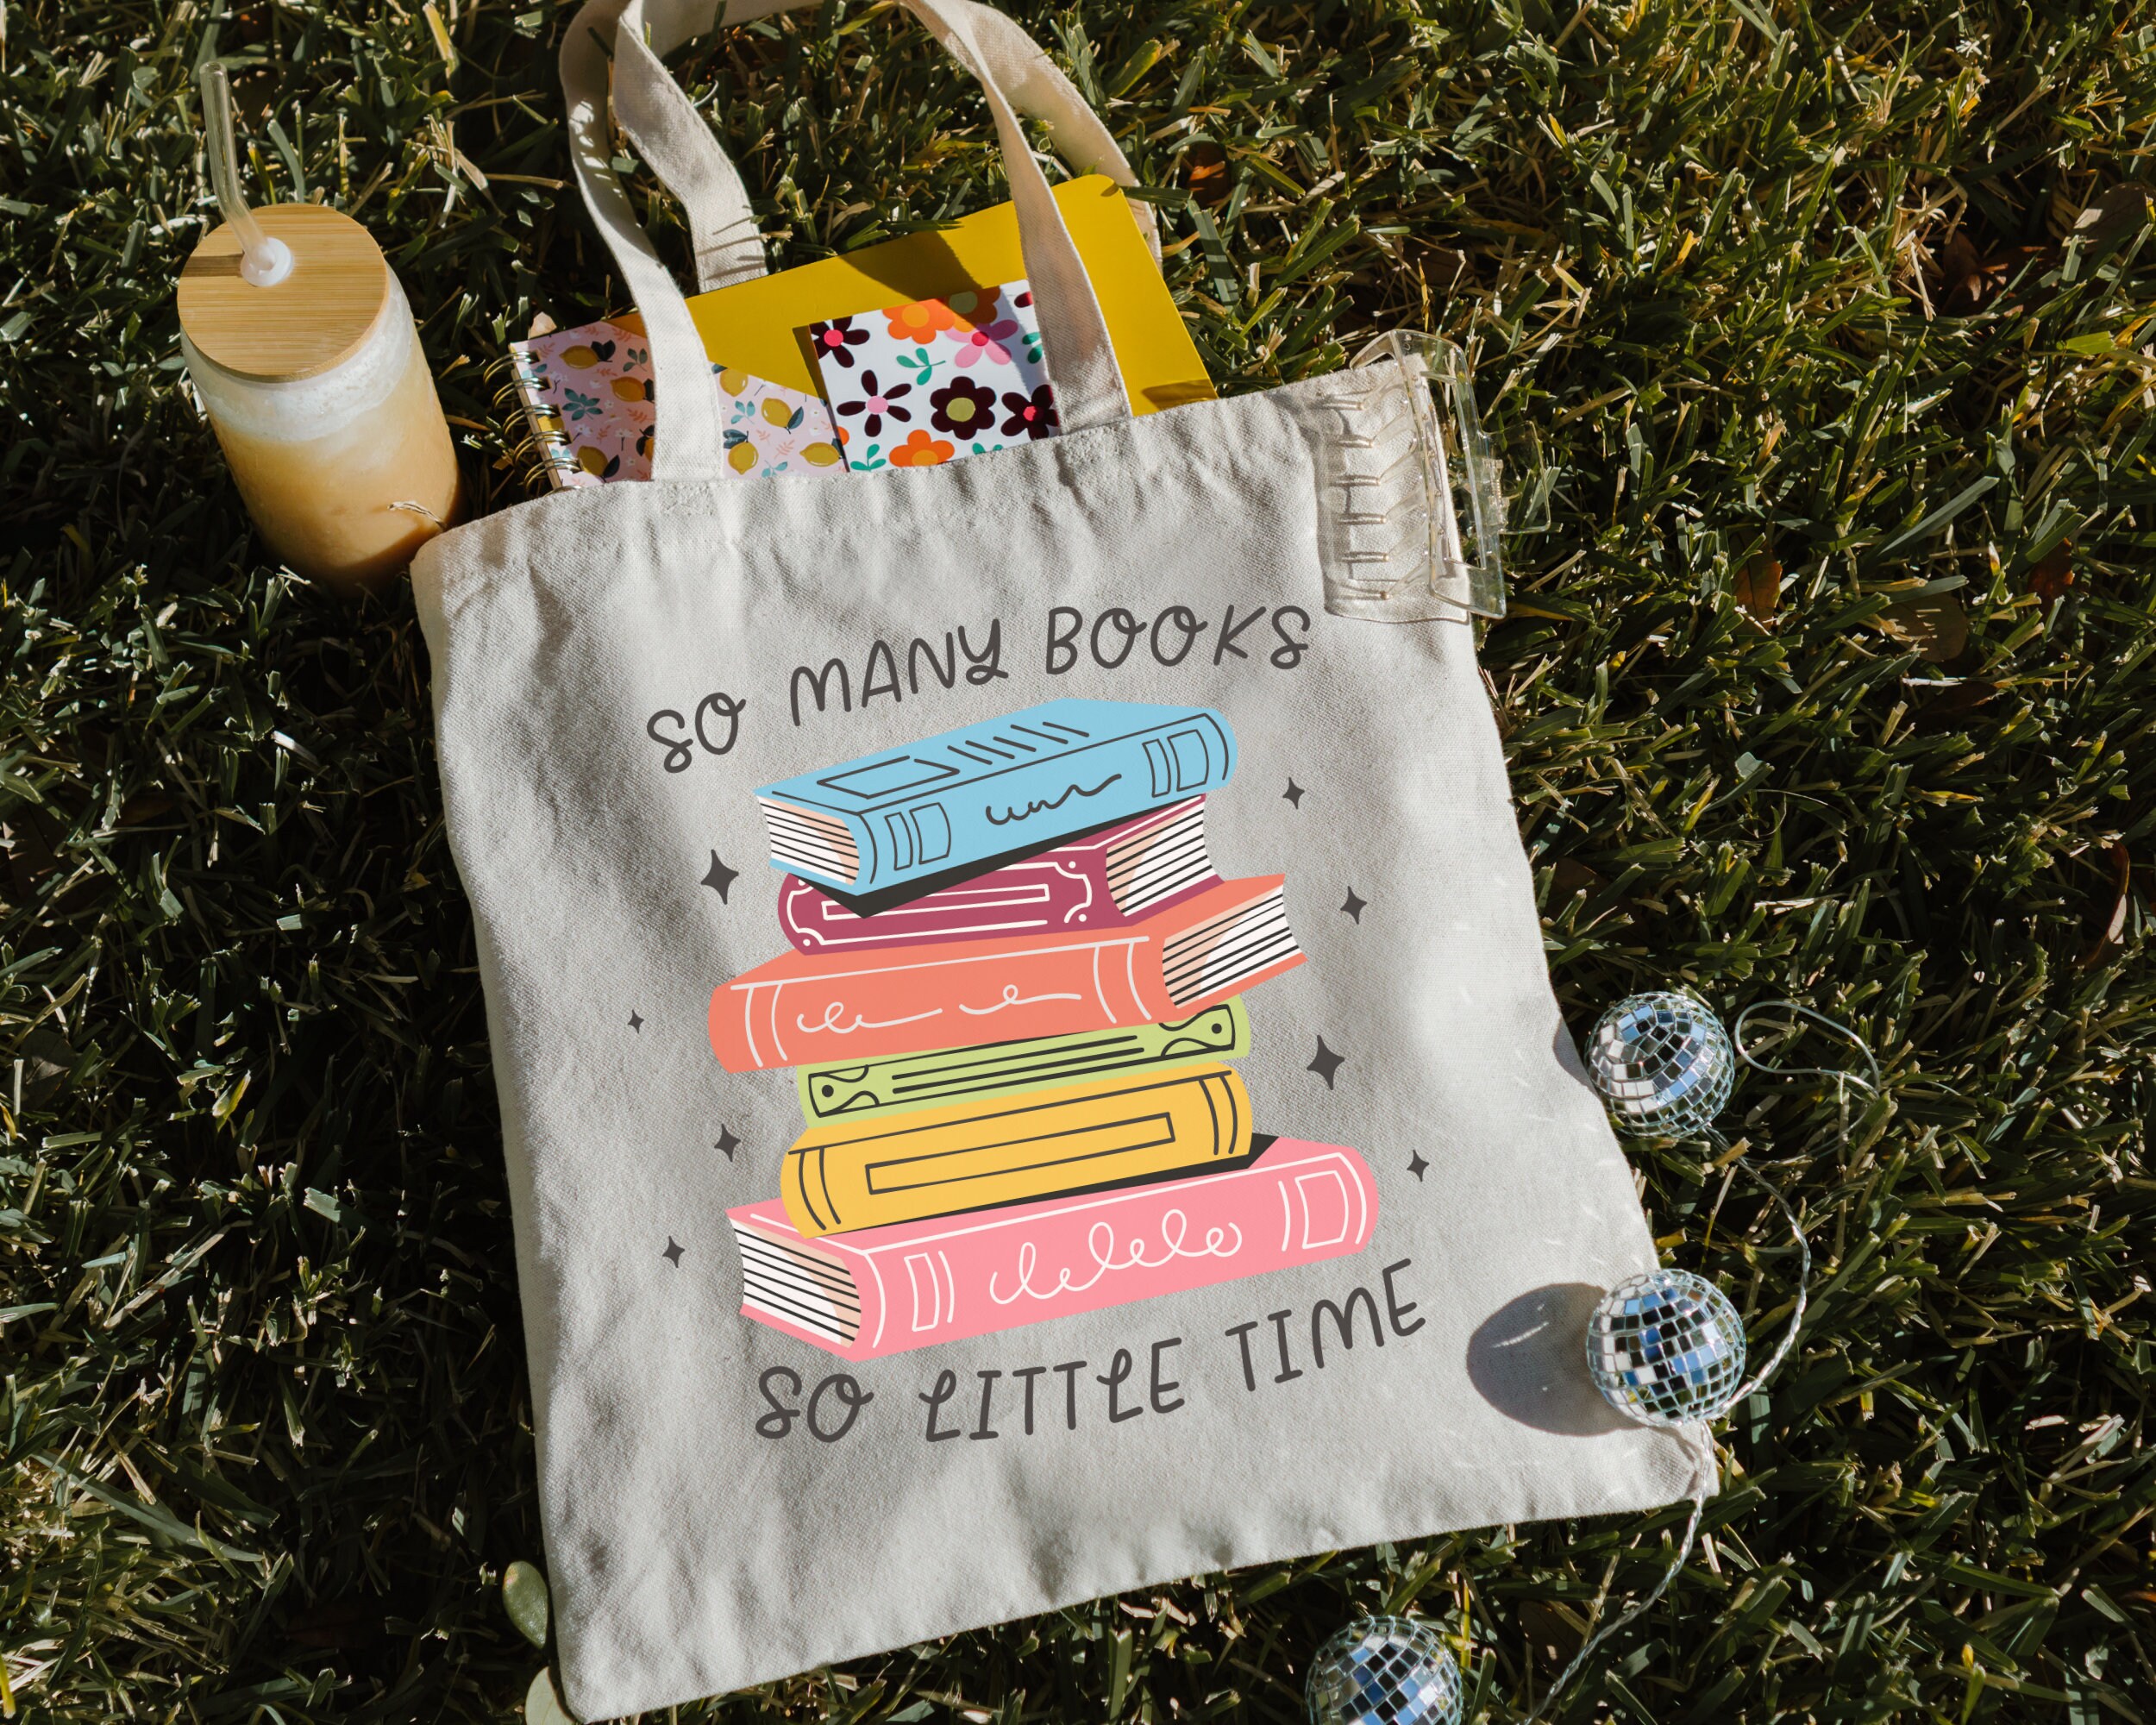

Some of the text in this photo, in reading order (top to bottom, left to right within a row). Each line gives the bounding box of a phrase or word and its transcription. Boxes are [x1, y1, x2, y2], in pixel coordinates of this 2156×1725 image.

[646, 604, 1311, 774] SO MANY BOOKS
[755, 1258, 1426, 1444] SO LITTLE TIME
